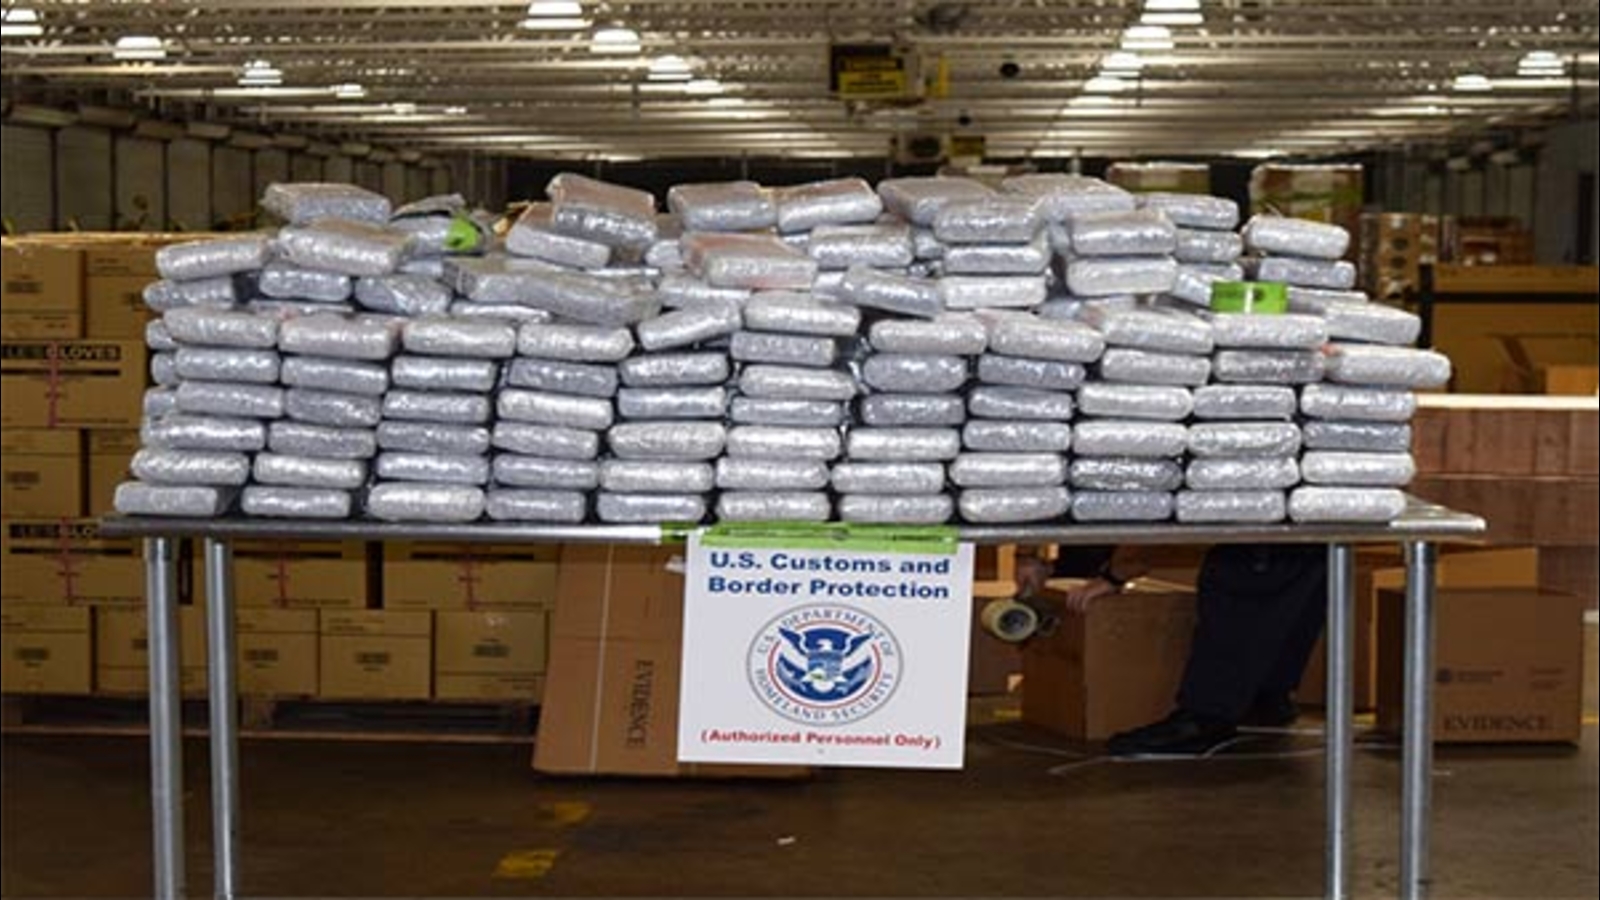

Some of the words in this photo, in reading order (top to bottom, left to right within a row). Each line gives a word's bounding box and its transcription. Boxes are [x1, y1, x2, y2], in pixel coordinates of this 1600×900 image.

[710, 552, 763, 569] U.S.
[770, 553, 891, 573] Customs
[900, 558, 949, 574] and
[708, 576, 801, 594] Border
[809, 579, 949, 598] Protection
[780, 609, 885, 641] DEPARTMENT
[626, 660, 654, 748] EVIDENCE
[754, 667, 826, 720] HOMELAND
[831, 670, 893, 720] SECURITY
[700, 729, 801, 744] (Authorized
[806, 732, 891, 746] Personnel
[895, 733, 941, 749] Only)
